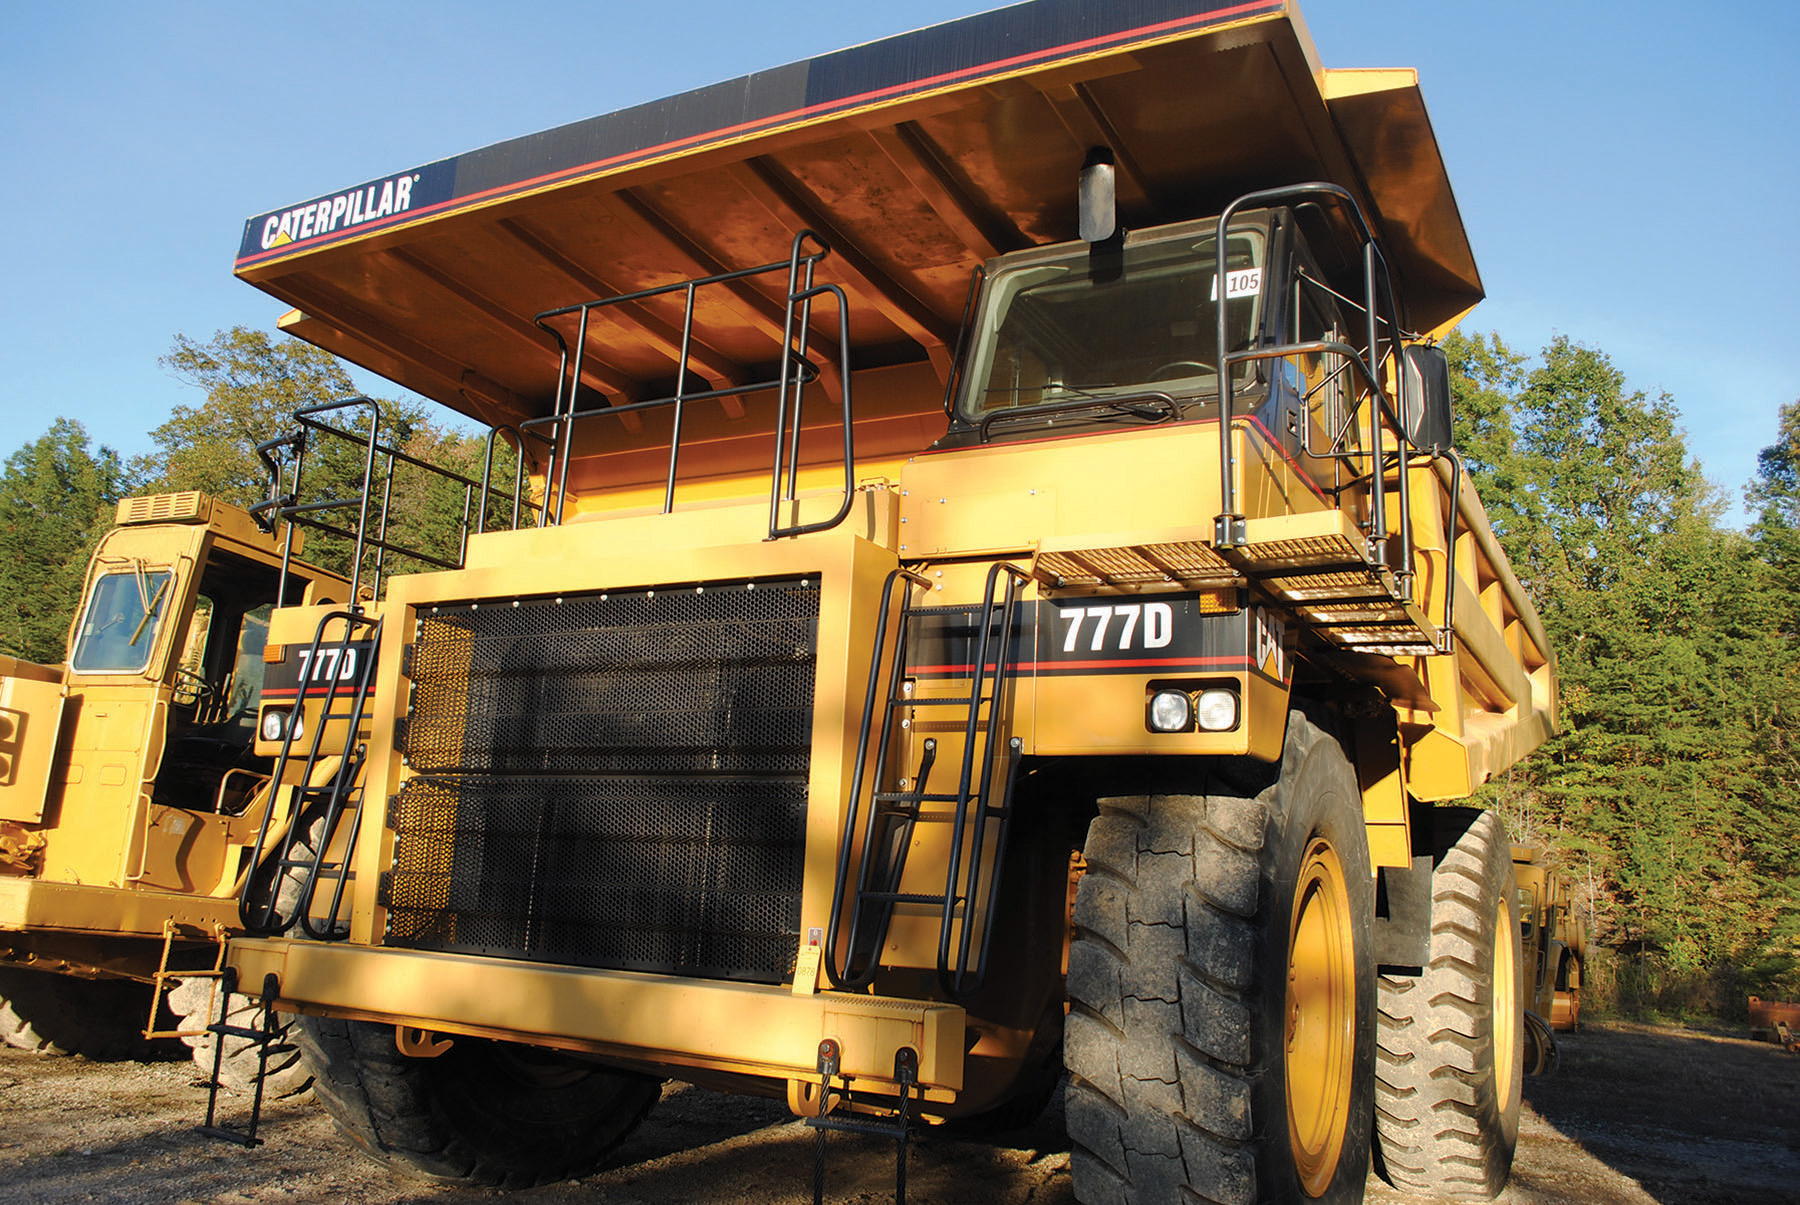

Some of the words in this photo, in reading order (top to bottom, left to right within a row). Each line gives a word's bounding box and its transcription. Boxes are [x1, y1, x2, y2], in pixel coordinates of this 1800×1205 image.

[261, 175, 413, 250] CATERPILLAR
[1229, 273, 1259, 293] 105
[1059, 602, 1173, 652] 777D
[1256, 605, 1285, 683] CAT
[297, 648, 357, 682] 777D
